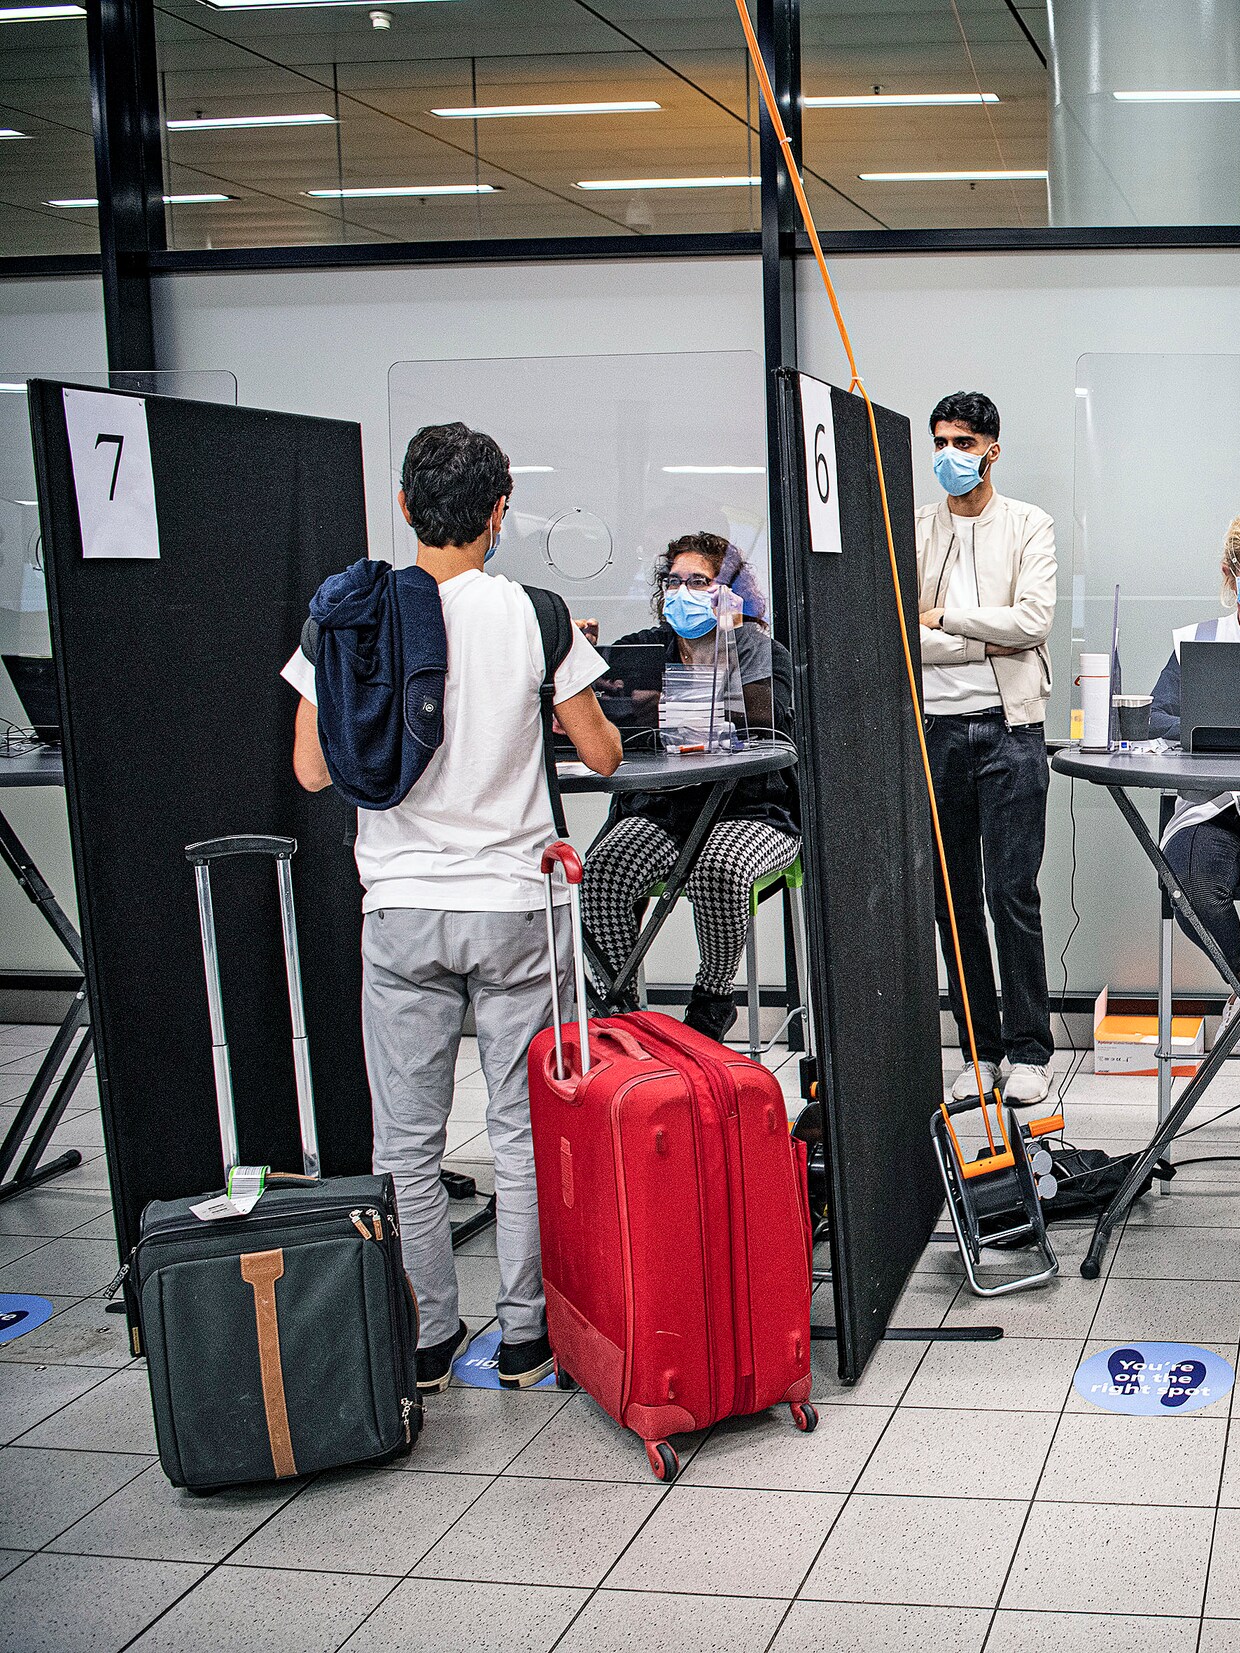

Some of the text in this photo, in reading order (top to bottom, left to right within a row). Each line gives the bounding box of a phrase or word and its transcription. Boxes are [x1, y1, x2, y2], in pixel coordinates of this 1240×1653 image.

[94, 433, 125, 501] 7
[814, 423, 830, 504] 6
[465, 1357, 500, 1370] rig
[1119, 1359, 1195, 1372] You're
[1114, 1372, 1193, 1384] on the
[1090, 1382, 1211, 1398] right spot
